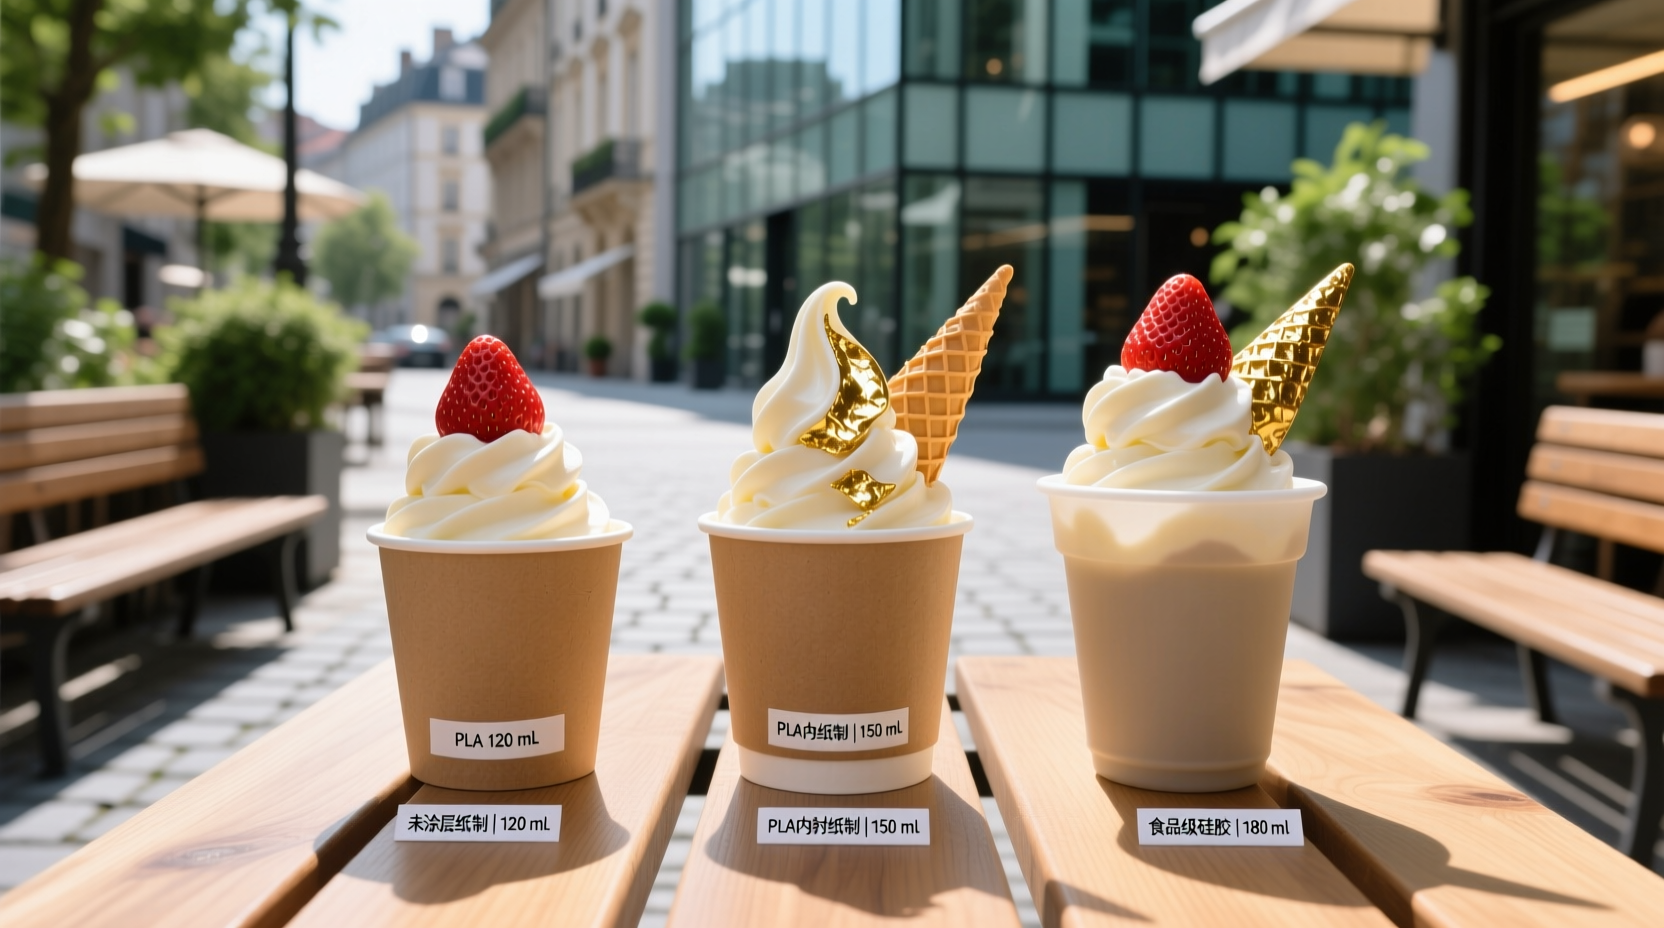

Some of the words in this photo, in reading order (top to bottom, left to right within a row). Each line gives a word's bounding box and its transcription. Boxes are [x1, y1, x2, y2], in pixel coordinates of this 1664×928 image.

[455, 732, 484, 748] PLA
[488, 732, 513, 748] 120
[518, 730, 540, 747] mL
[860, 722, 883, 740] 150
[407, 813, 489, 833] 未涂层纸制
[500, 815, 527, 831] 120
[871, 818, 897, 835] 150
[1148, 816, 1232, 837] 食品级硅胶
[1242, 819, 1268, 836] 180
